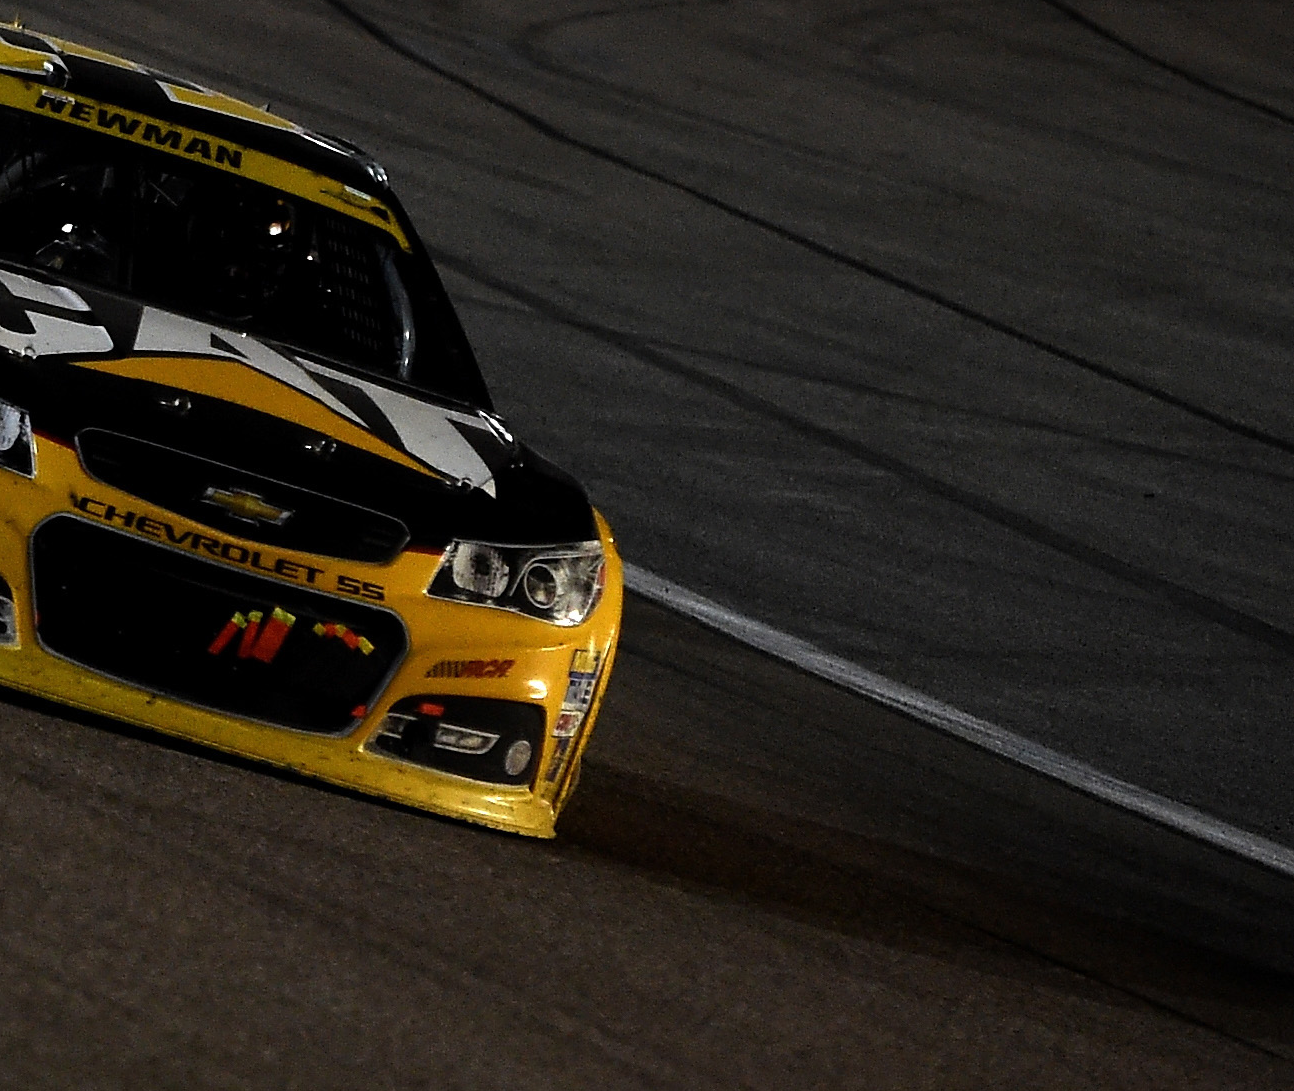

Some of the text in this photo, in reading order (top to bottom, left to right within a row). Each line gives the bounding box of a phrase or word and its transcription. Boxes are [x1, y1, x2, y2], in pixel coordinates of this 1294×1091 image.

[35, 94, 244, 169] NEWMAN
[79, 496, 386, 601] CHEVROLET SS
